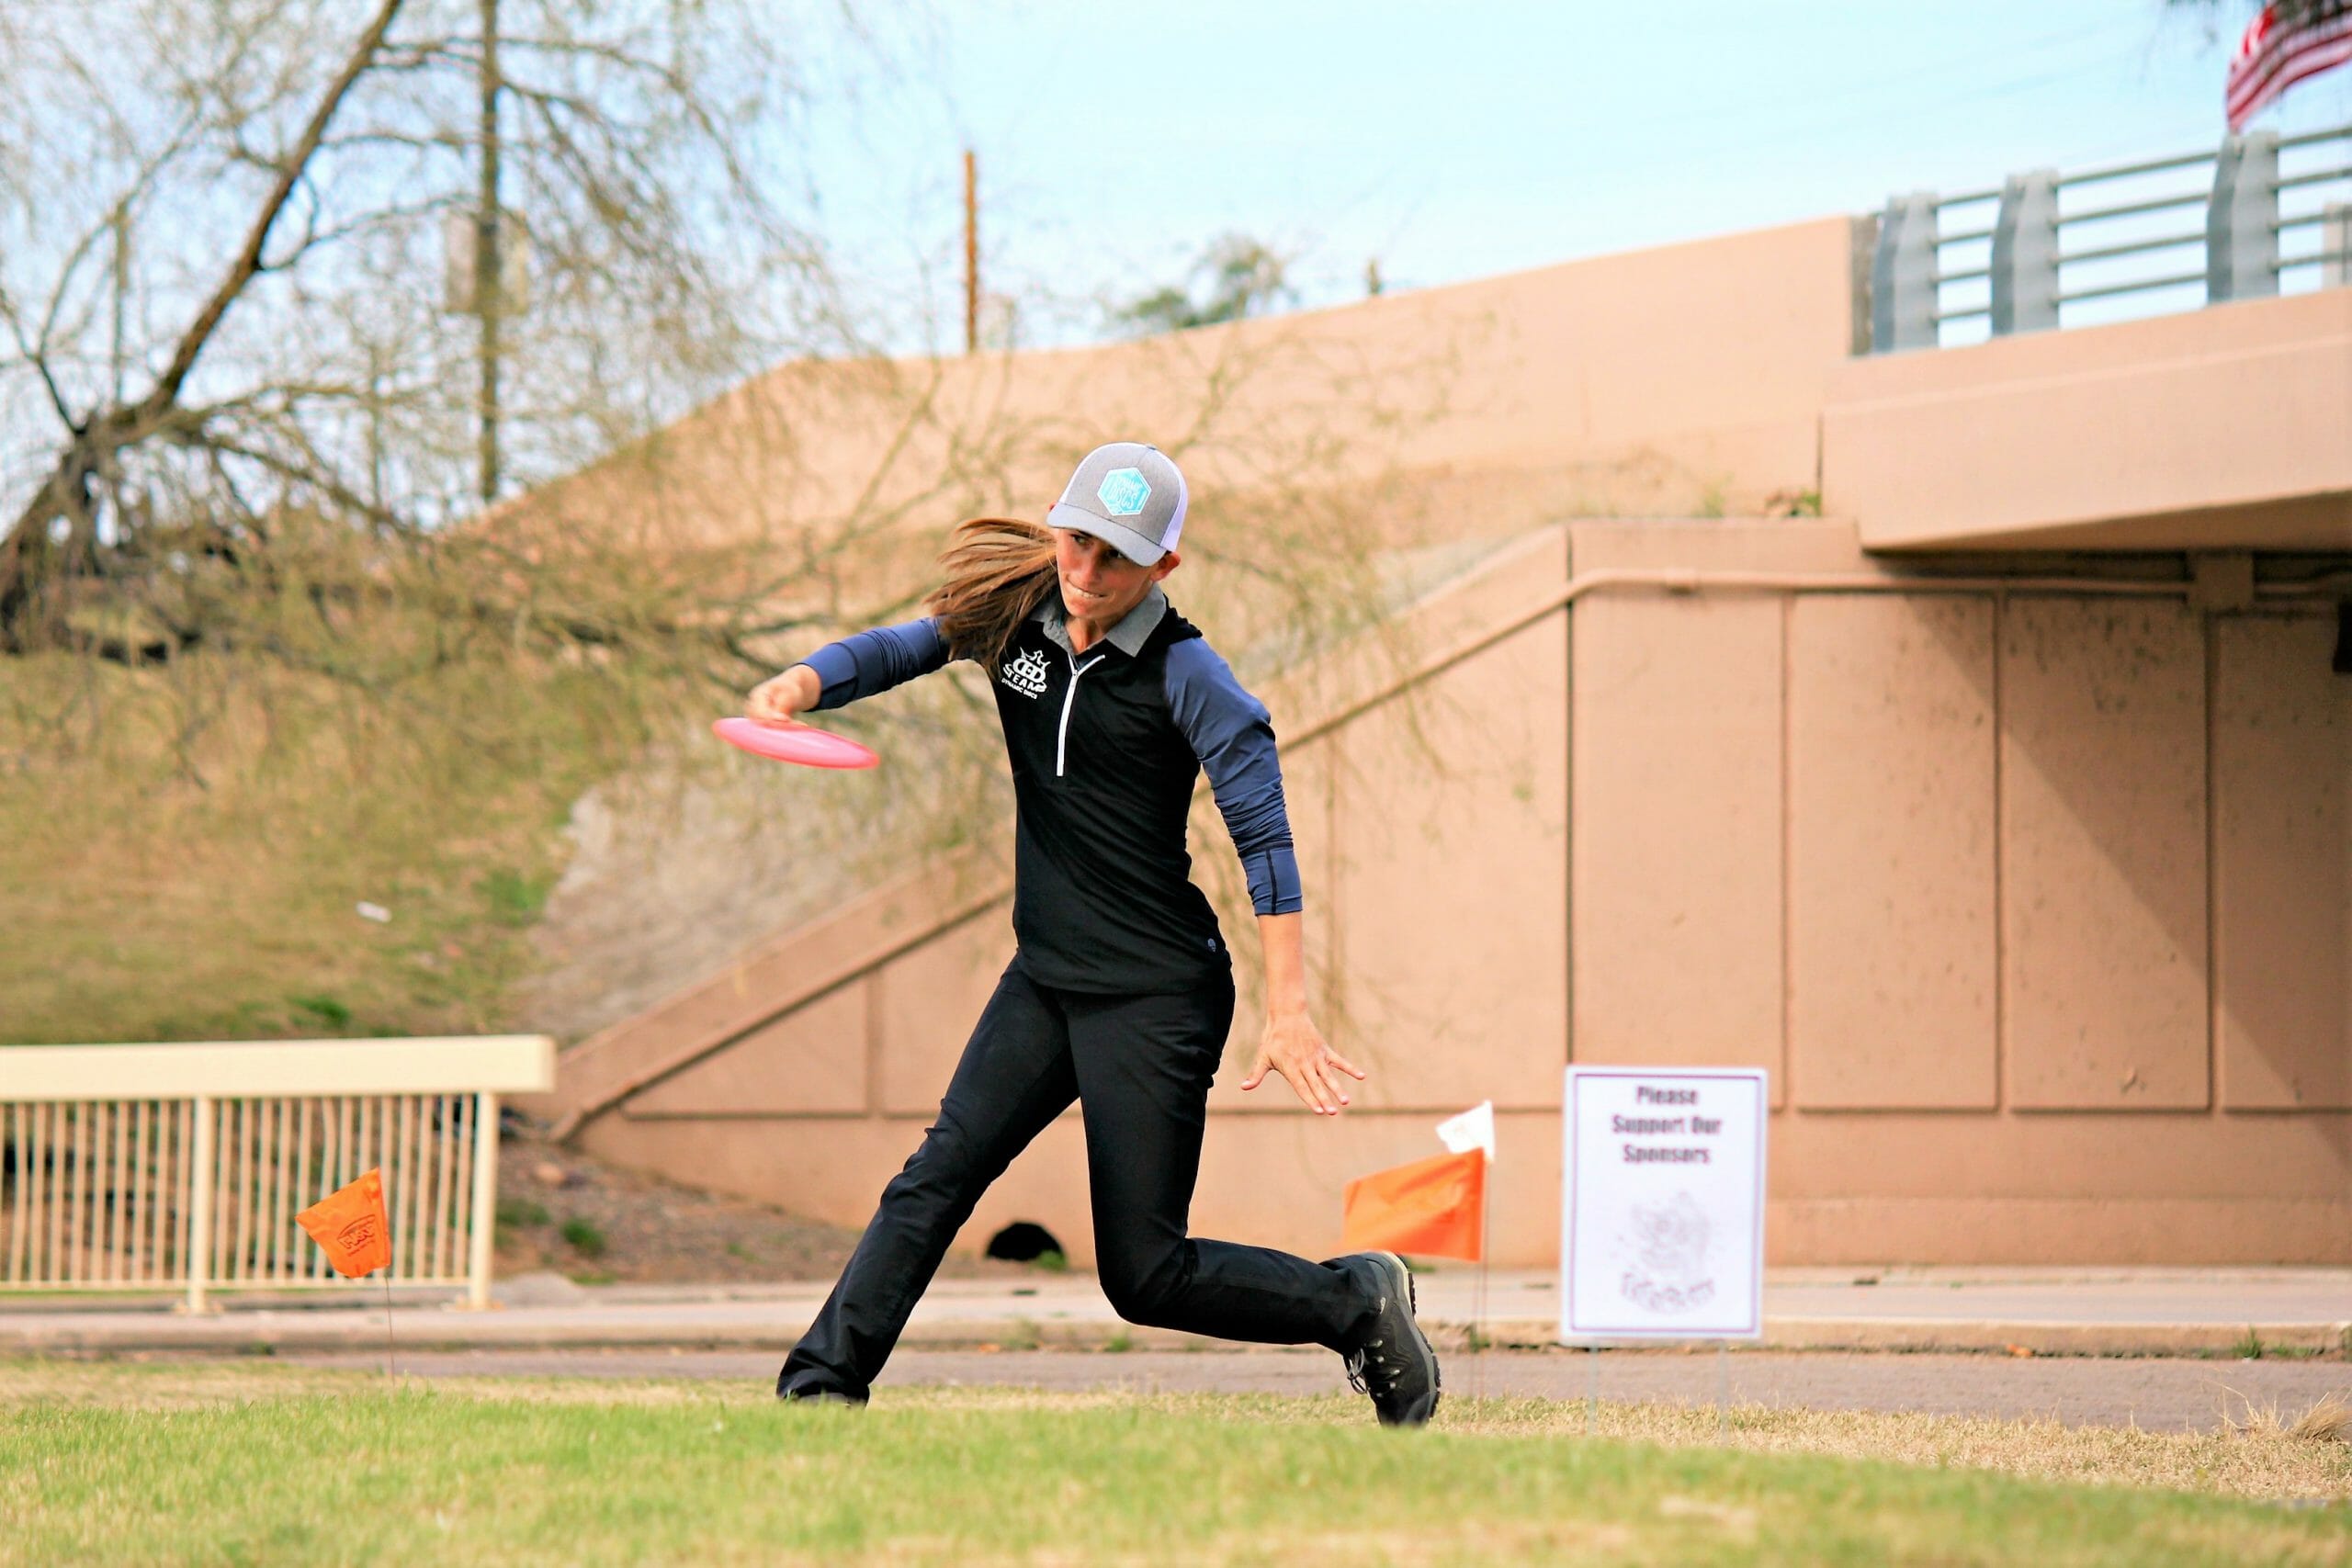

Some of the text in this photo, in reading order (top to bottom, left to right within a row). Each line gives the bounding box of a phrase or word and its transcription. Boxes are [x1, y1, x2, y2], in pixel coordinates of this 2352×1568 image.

[1007, 670, 1039, 692] TEAM
[1635, 1086, 1699, 1105] Please
[1612, 1114, 1723, 1134] Support Our
[1623, 1144, 1712, 1164] Sponsors
